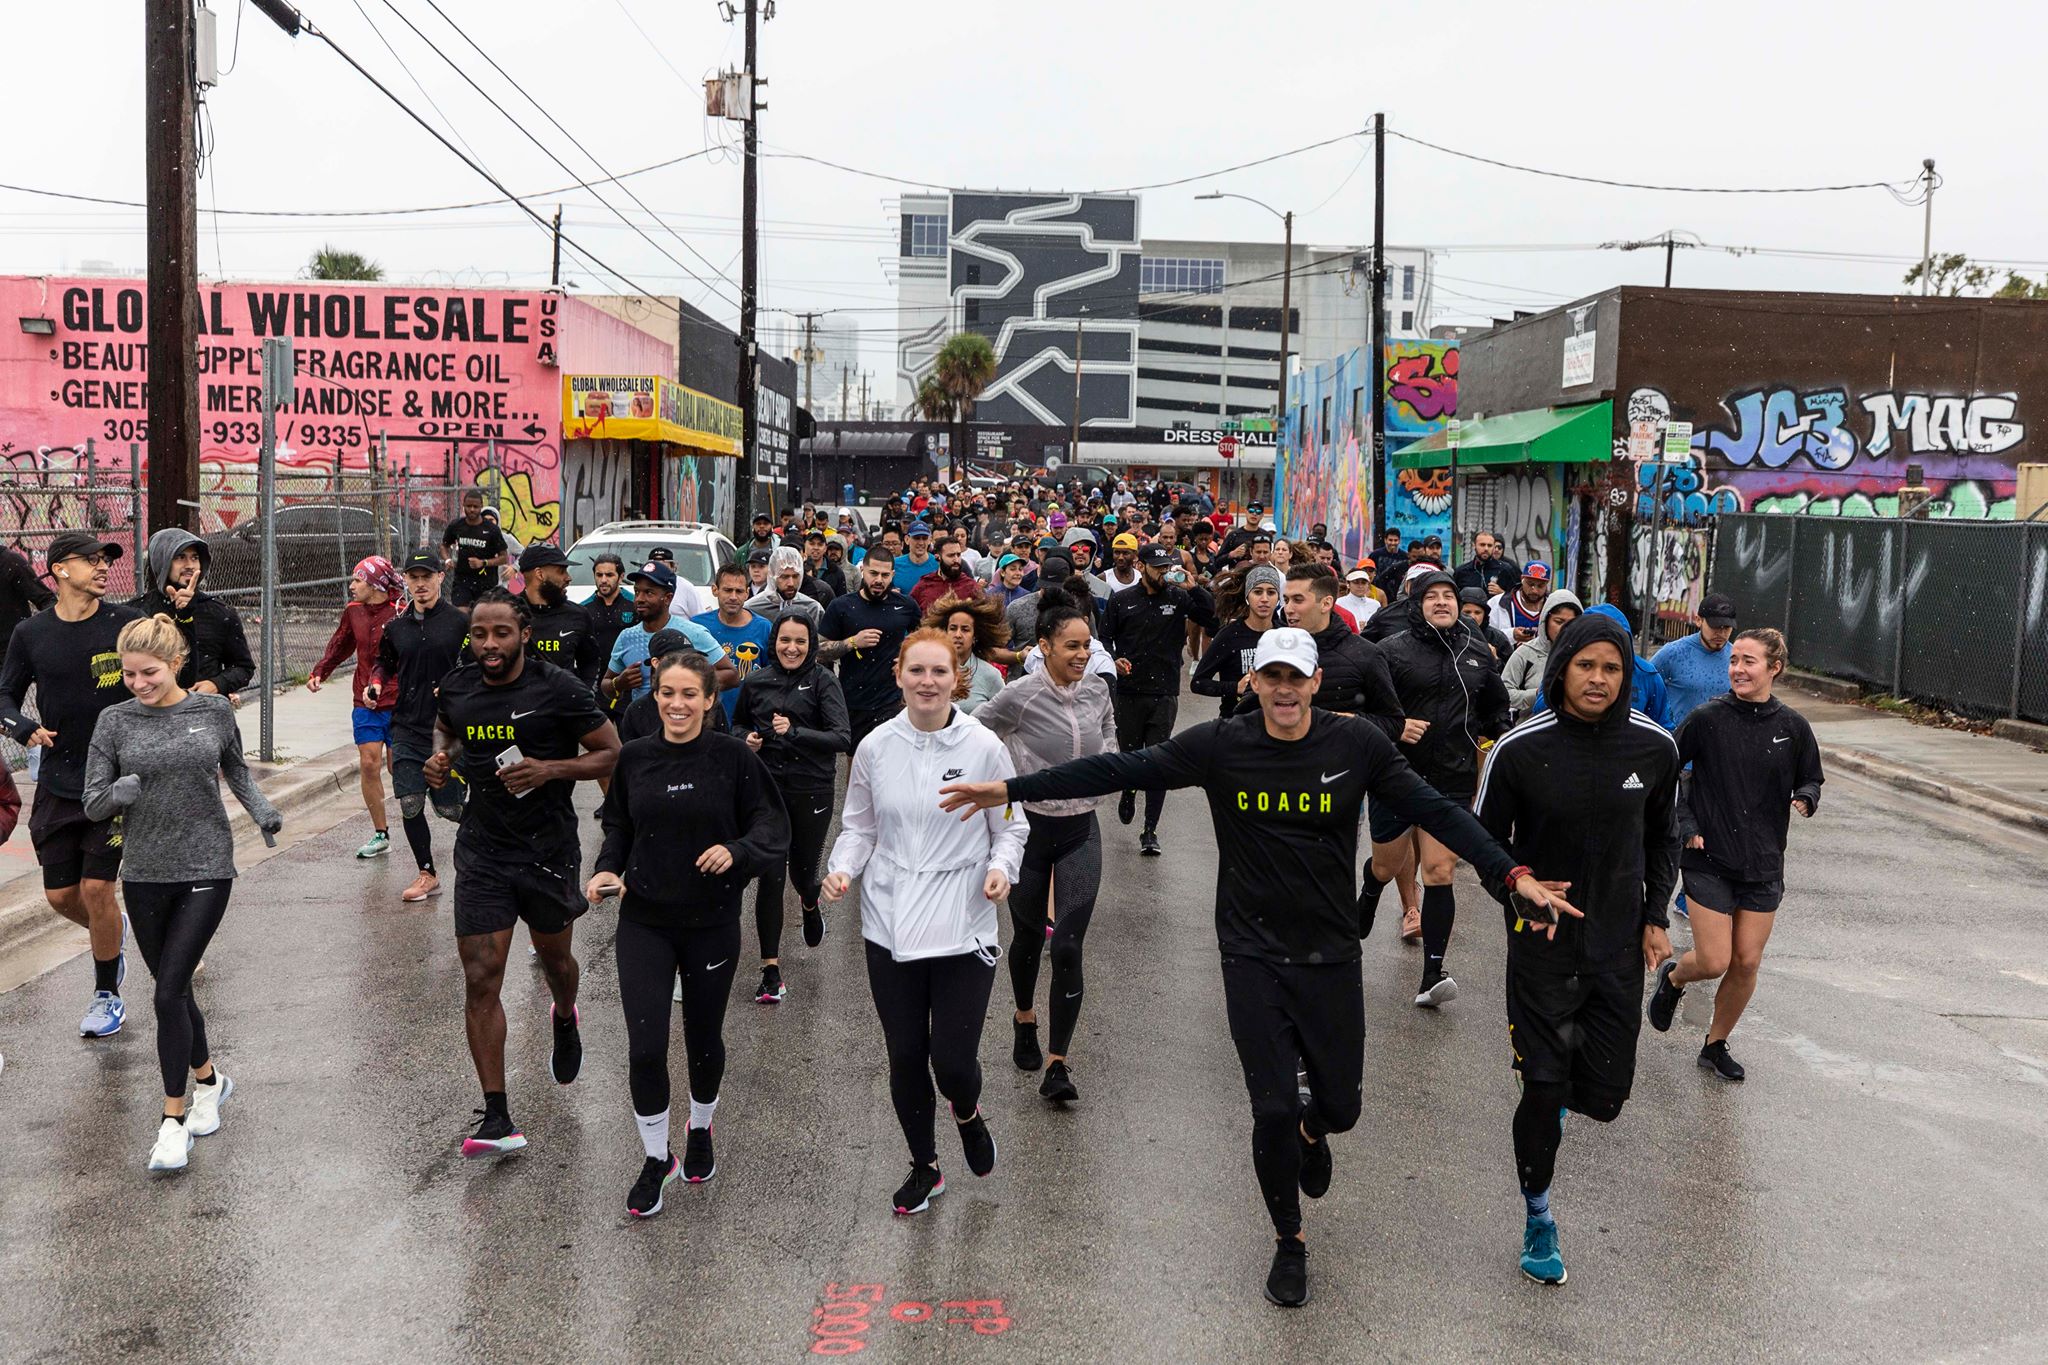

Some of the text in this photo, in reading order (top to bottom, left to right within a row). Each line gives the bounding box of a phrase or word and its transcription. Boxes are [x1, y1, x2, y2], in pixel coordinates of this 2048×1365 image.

[63, 287, 529, 344] GLOL WHOLESALE
[537, 299, 557, 360] USA
[63, 341, 148, 372] BEAUT
[293, 349, 456, 383] FRAGRANCE
[465, 354, 510, 384] OIL
[572, 377, 654, 392] GLOBAL WHOLESALE USA
[62, 379, 148, 410] GENE
[207, 384, 393, 417] MERHANDISE
[402, 389, 424, 418] &
[418, 421, 504, 438] OPEN
[1639, 423, 1649, 433] NO
[1860, 392, 2025, 459] MAG
[300, 424, 362, 448] 9335
[1163, 429, 1277, 445] DRESS HALL
[1632, 432, 1654, 440] PARKING
[466, 725, 515, 740] PACER
[946, 768, 964, 776] NIKE
[666, 784, 679, 792] Just
[1237, 791, 1331, 813] COACH
